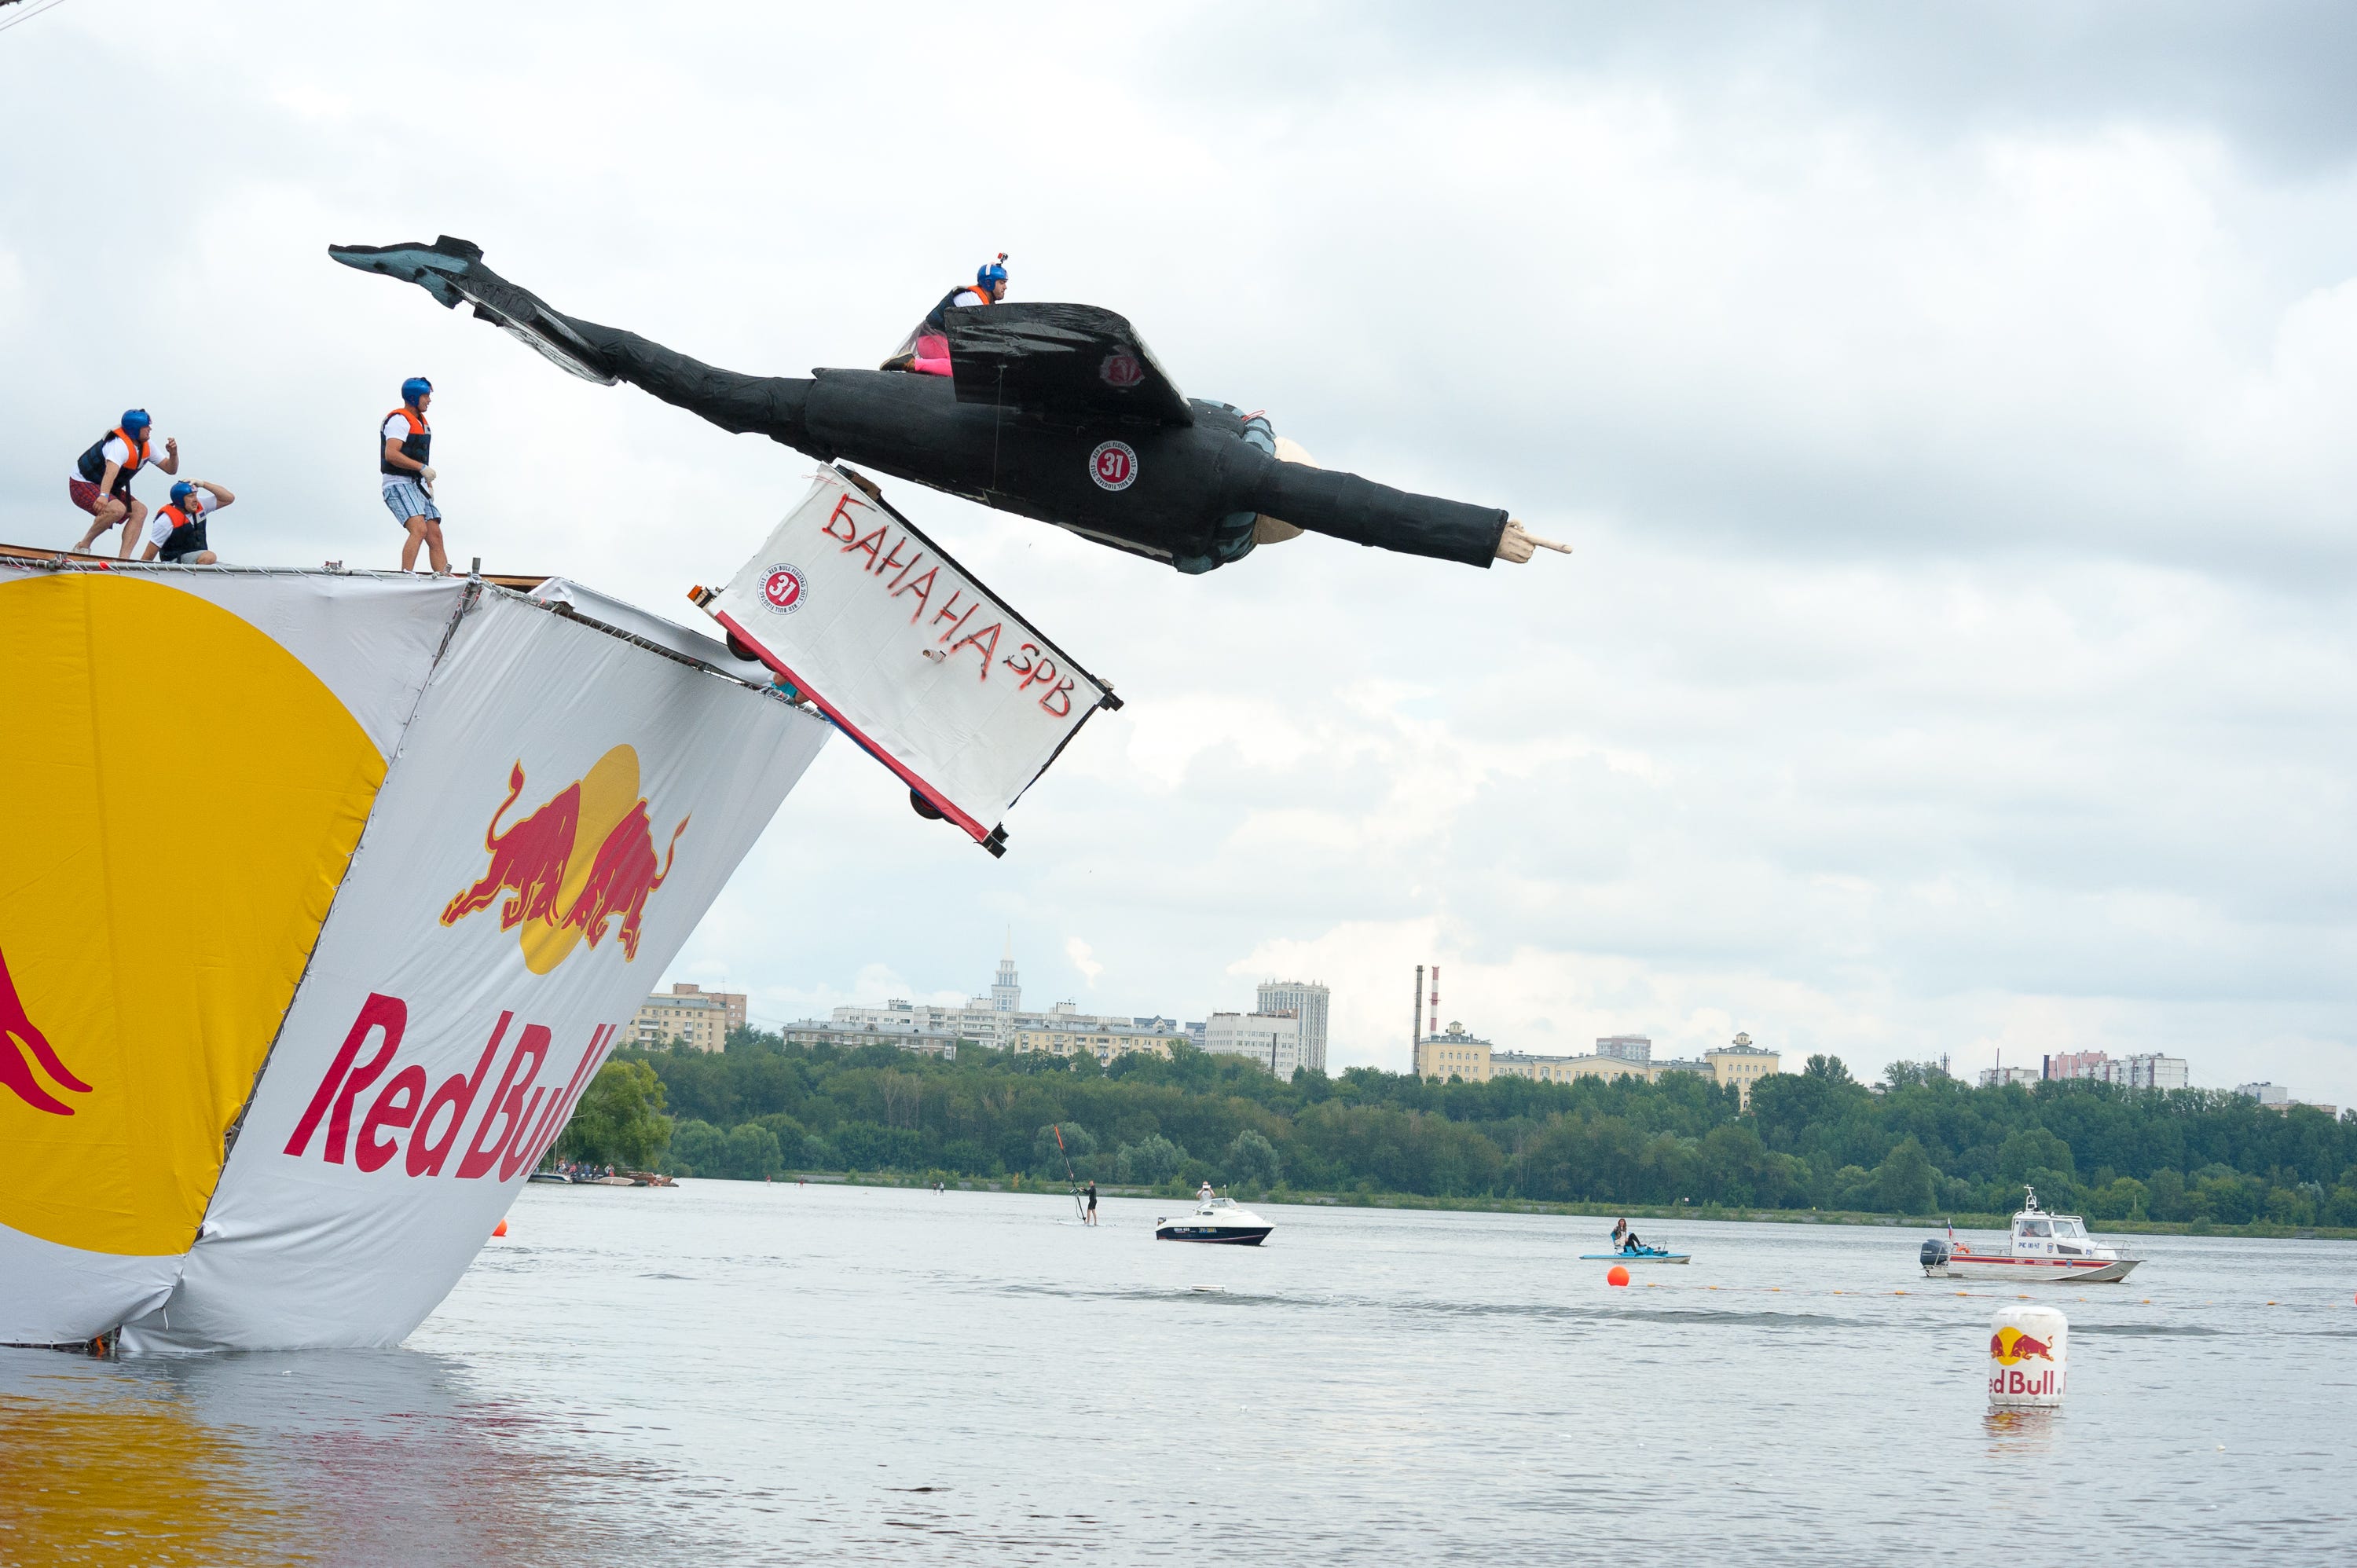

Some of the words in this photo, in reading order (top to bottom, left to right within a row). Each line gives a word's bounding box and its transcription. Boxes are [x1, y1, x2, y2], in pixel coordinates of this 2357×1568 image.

[1113, 441, 1132, 455] FLUGTAG
[1101, 452, 1124, 478] 31
[768, 574, 797, 603] 31
[791, 568, 806, 588] FLUGTAG
[282, 991, 515, 1178] Red
[454, 1023, 618, 1183] Bull
[2009, 1370, 2054, 1395] Bull
